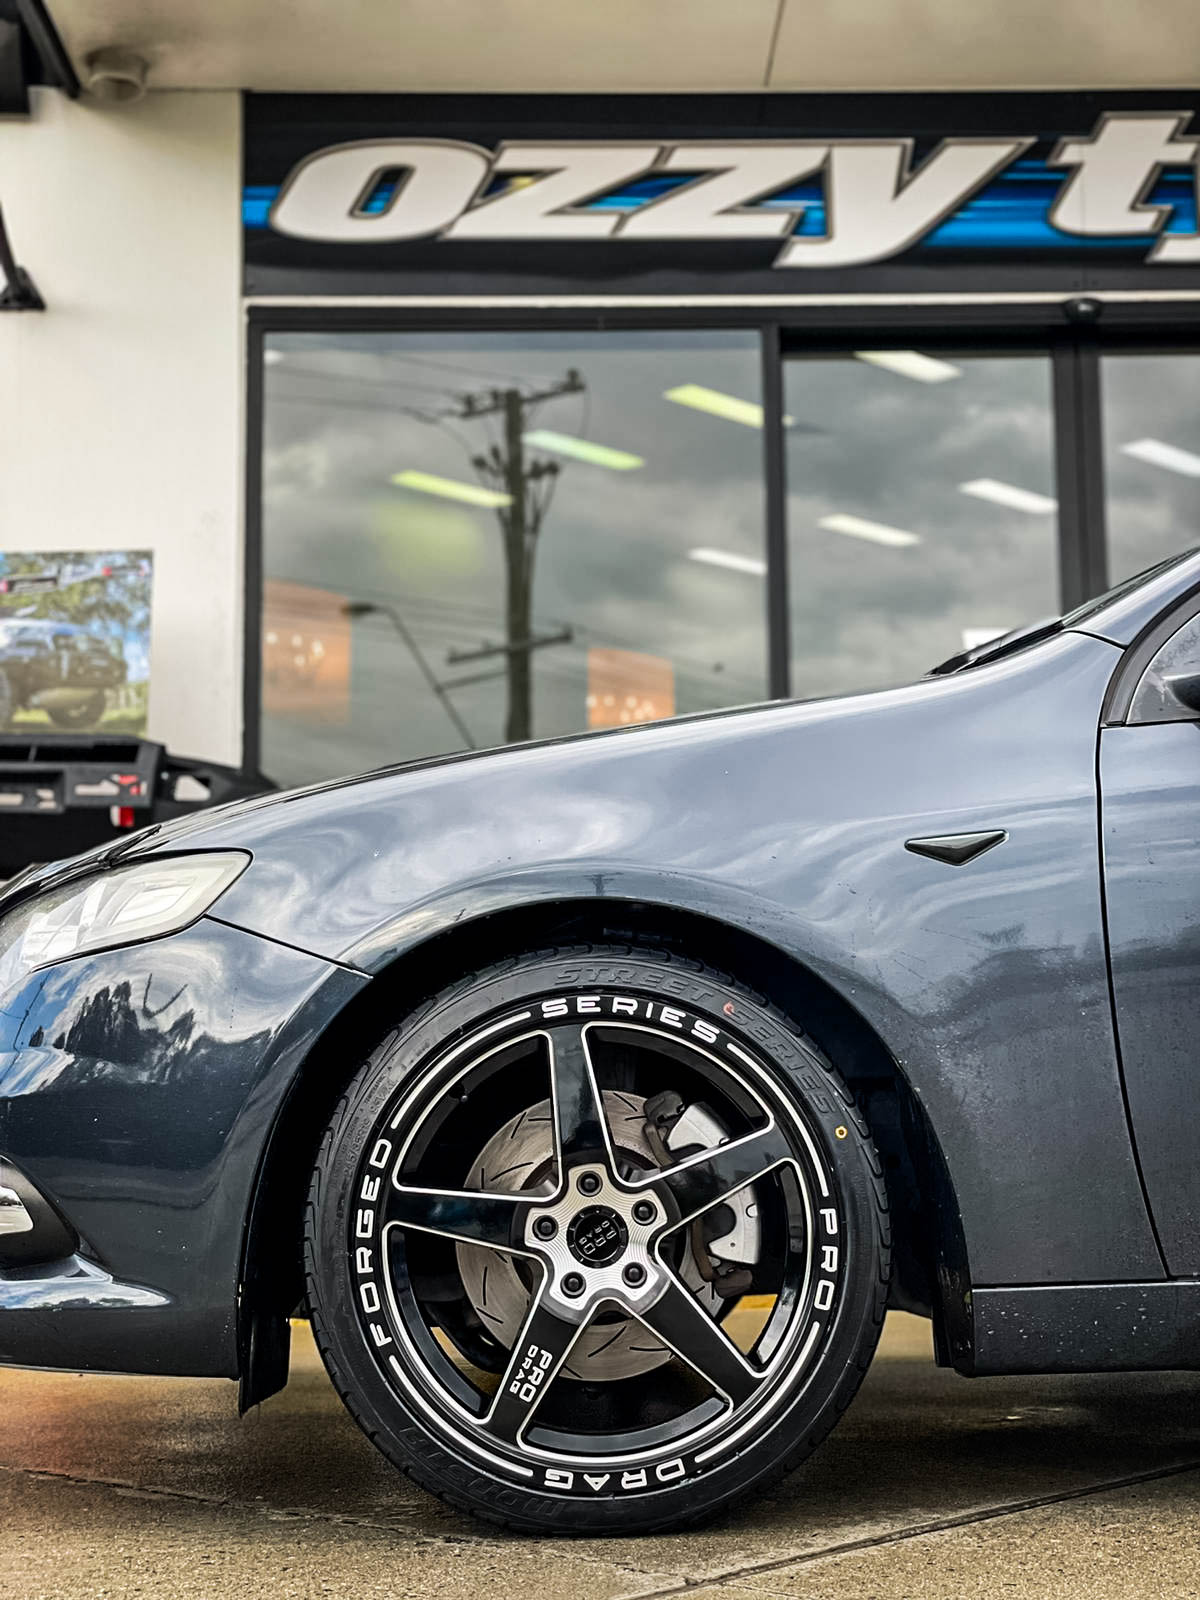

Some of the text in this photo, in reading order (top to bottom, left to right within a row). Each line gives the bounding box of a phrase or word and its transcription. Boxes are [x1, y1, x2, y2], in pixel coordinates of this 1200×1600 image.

[268, 110, 1200, 269] ozzy t
[542, 996, 720, 1043] SERIES
[552, 966, 837, 1115] STREET SERIES
[356, 1139, 392, 1346] FORGED
[579, 1220, 610, 1245] DRAG
[583, 1227, 617, 1254] PRO
[814, 1209, 838, 1310] PRO
[510, 1345, 538, 1394] DRAG
[519, 1350, 552, 1402] PRO
[544, 1458, 685, 1491] DRAG
